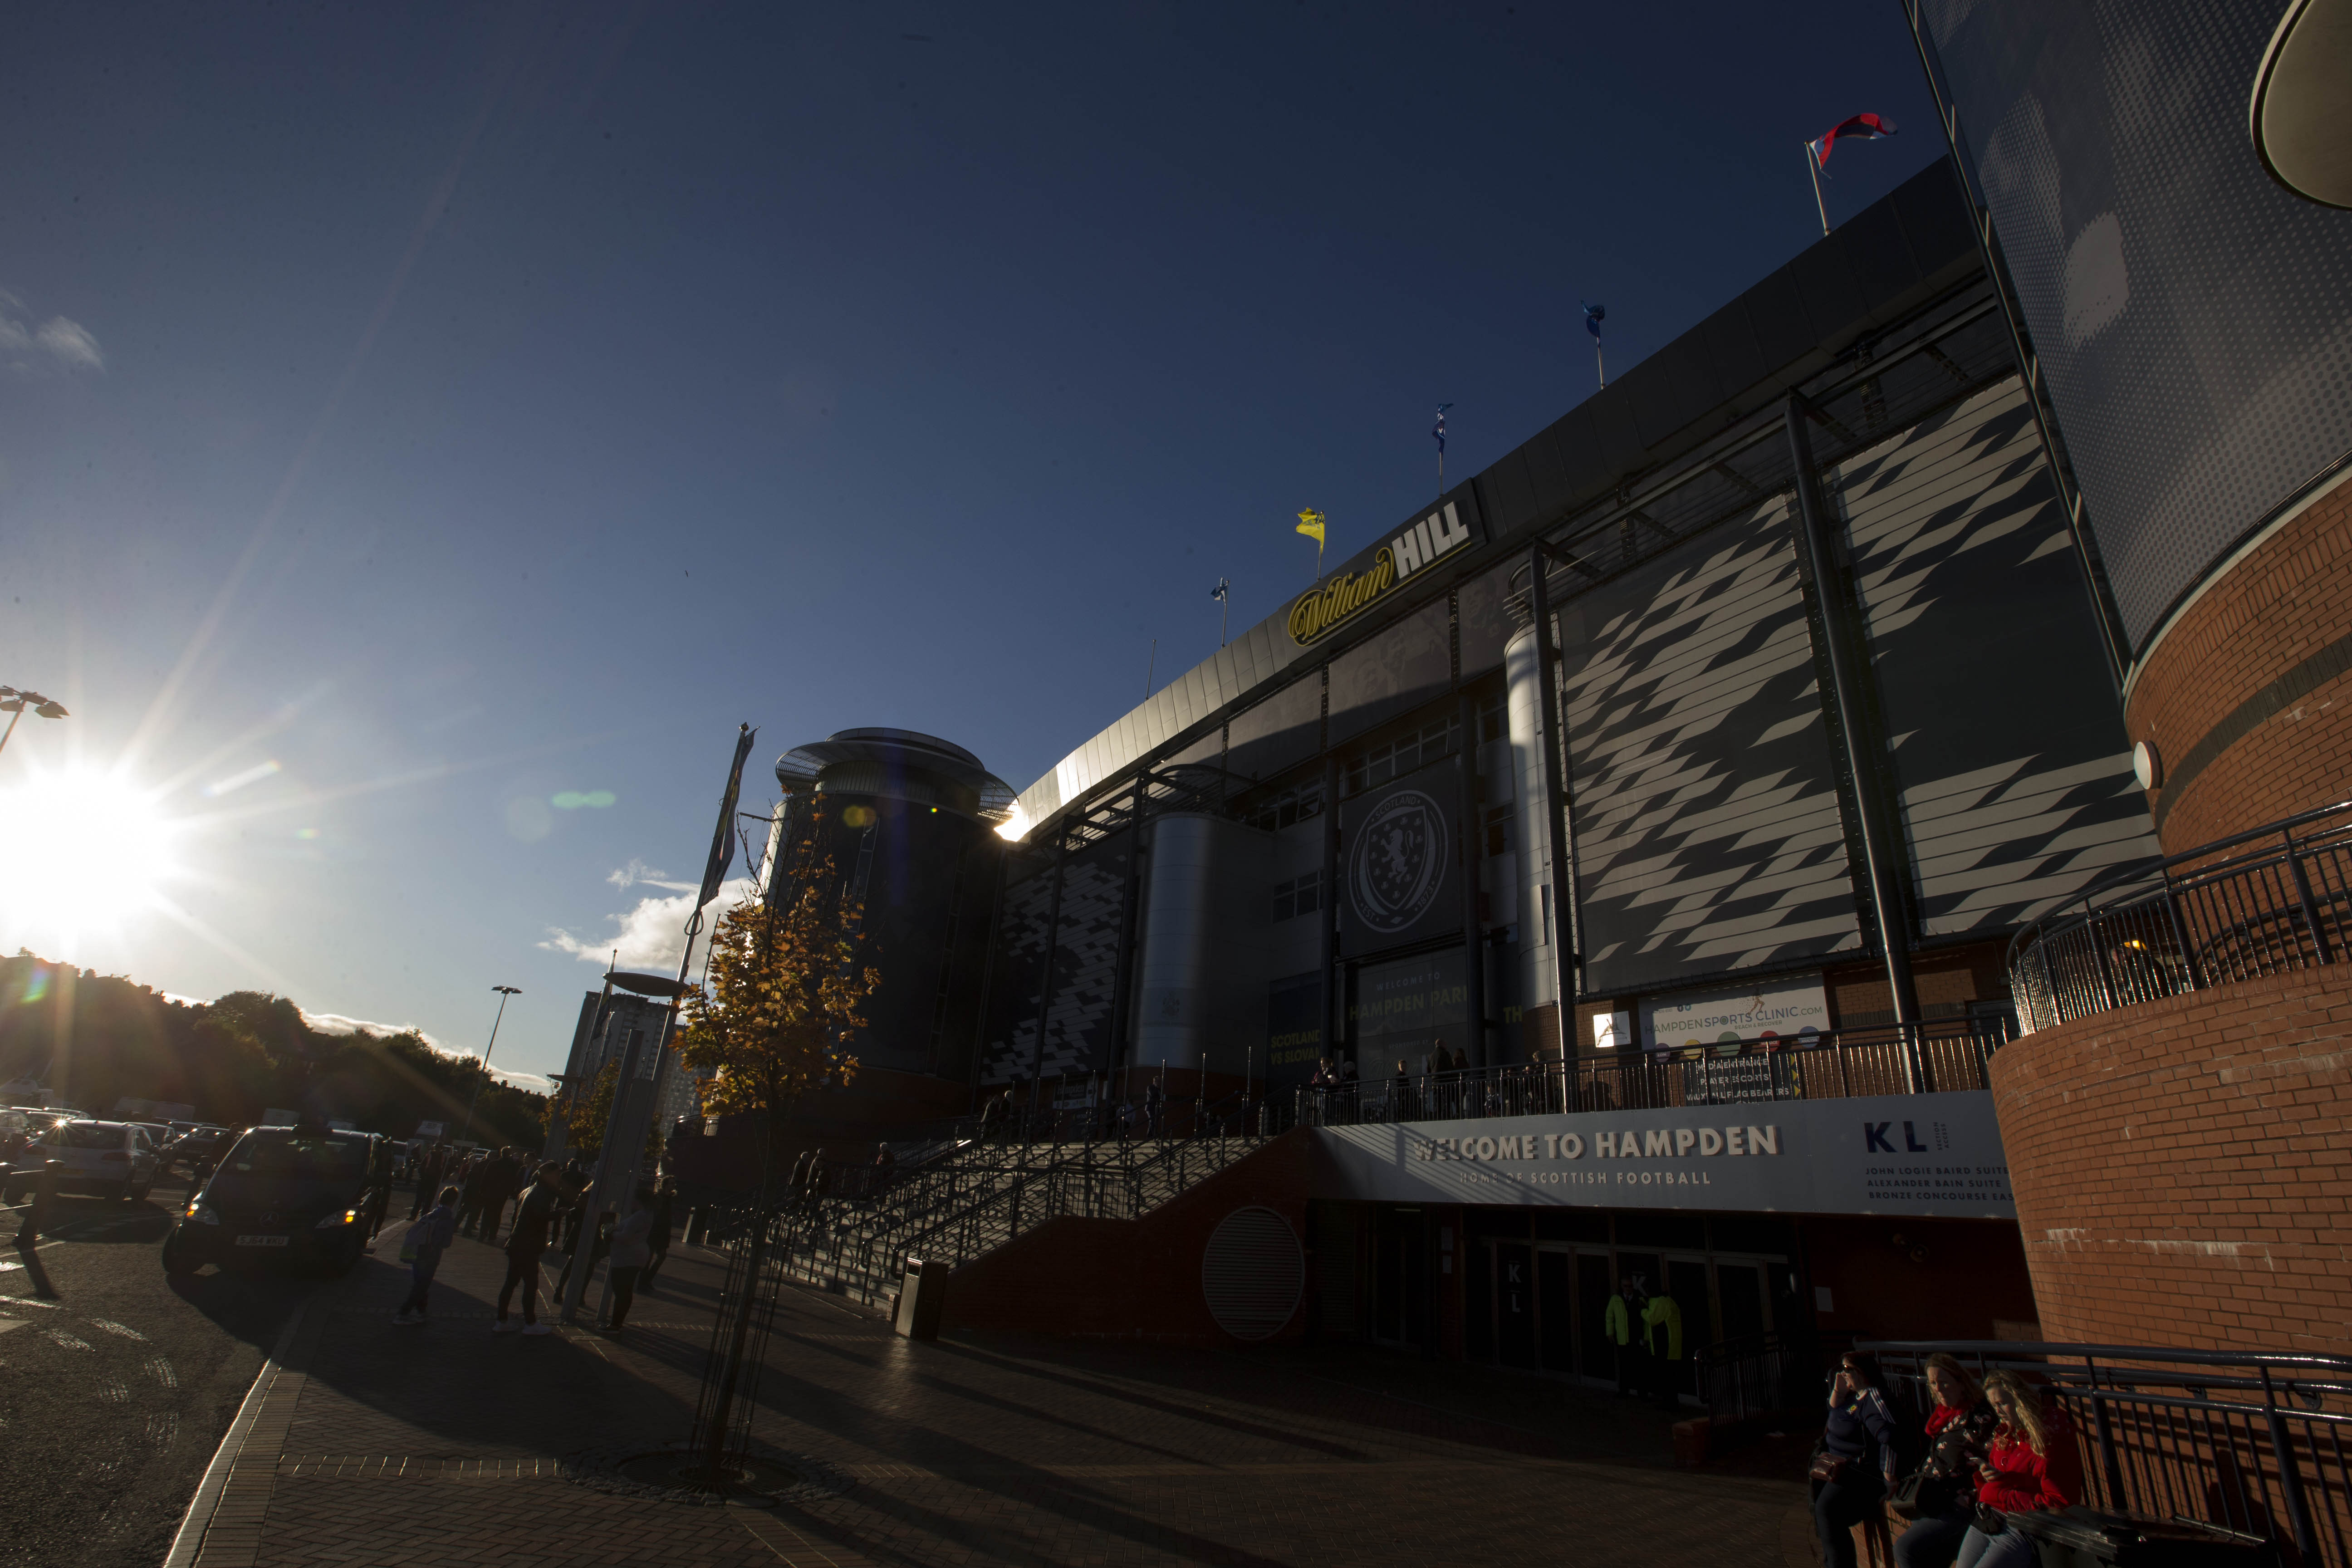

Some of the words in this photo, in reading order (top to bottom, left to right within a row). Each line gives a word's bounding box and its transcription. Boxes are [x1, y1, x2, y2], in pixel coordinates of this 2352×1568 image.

[1288, 547, 1394, 641] William
[1392, 501, 1470, 580] HILL
[1375, 795, 1416, 818] SCOTLAND
[1417, 885, 1434, 908] 1873
[1362, 906, 1376, 921] EST
[1376, 975, 1423, 991] WELCOME
[1428, 972, 1441, 981] TO
[1350, 993, 1425, 1021] HAMPDEN
[1758, 1020, 1783, 1028] RECOVER
[1270, 1053, 1283, 1065] VS
[1698, 1063, 1721, 1071] MDA
[1700, 1076, 1729, 1085] PAYER
[1686, 1092, 1726, 1101] VAUXALL
[1750, 1088, 1790, 1097] BEARRS
[1413, 1135, 1539, 1161] WELCOME
[1544, 1132, 1585, 1160] TO
[1595, 1125, 1779, 1158] HAMPDEN
[1933, 1122, 1943, 1151] SECTION
[1940, 1123, 1950, 1149] ACCESS
[1460, 1172, 1499, 1184] HOME
[1506, 1172, 1523, 1184] OF
[1531, 1172, 1607, 1184] SCOTTISH
[1617, 1171, 1711, 1185] FOOTBALL
[1916, 1192, 1988, 1200] CONCOURSE
[1631, 1275, 1648, 1297] K
